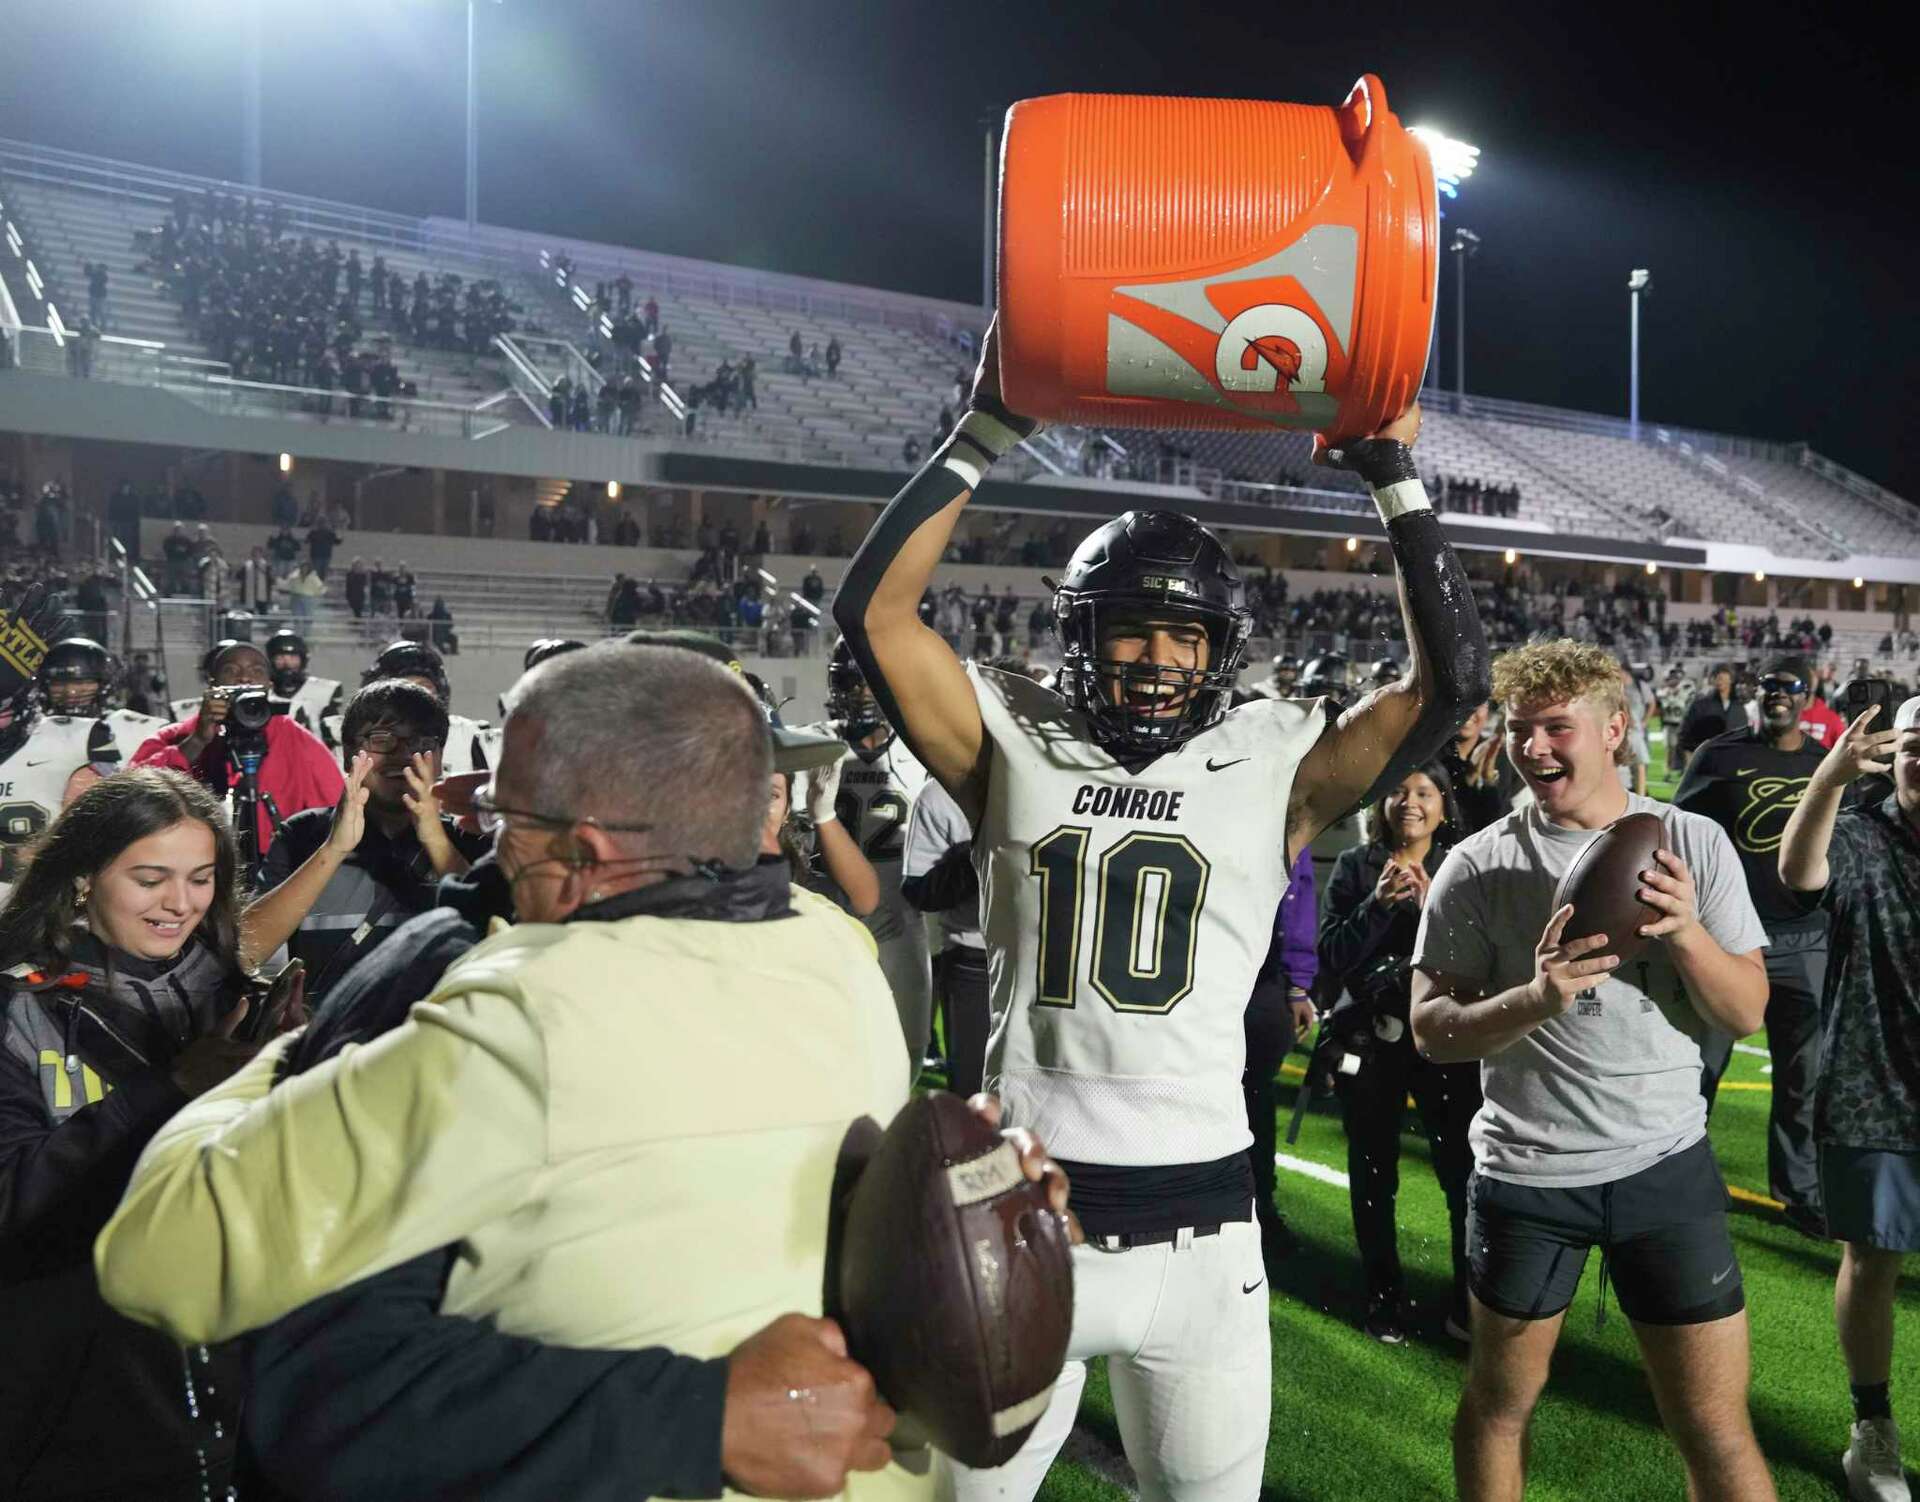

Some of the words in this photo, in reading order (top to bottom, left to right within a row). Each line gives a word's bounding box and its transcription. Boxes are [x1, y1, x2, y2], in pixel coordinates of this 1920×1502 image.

[1143, 575, 1163, 588] SIC
[845, 770, 890, 784] CONROE
[1072, 784, 1184, 821] CONROE
[1030, 824, 1211, 1016] 10
